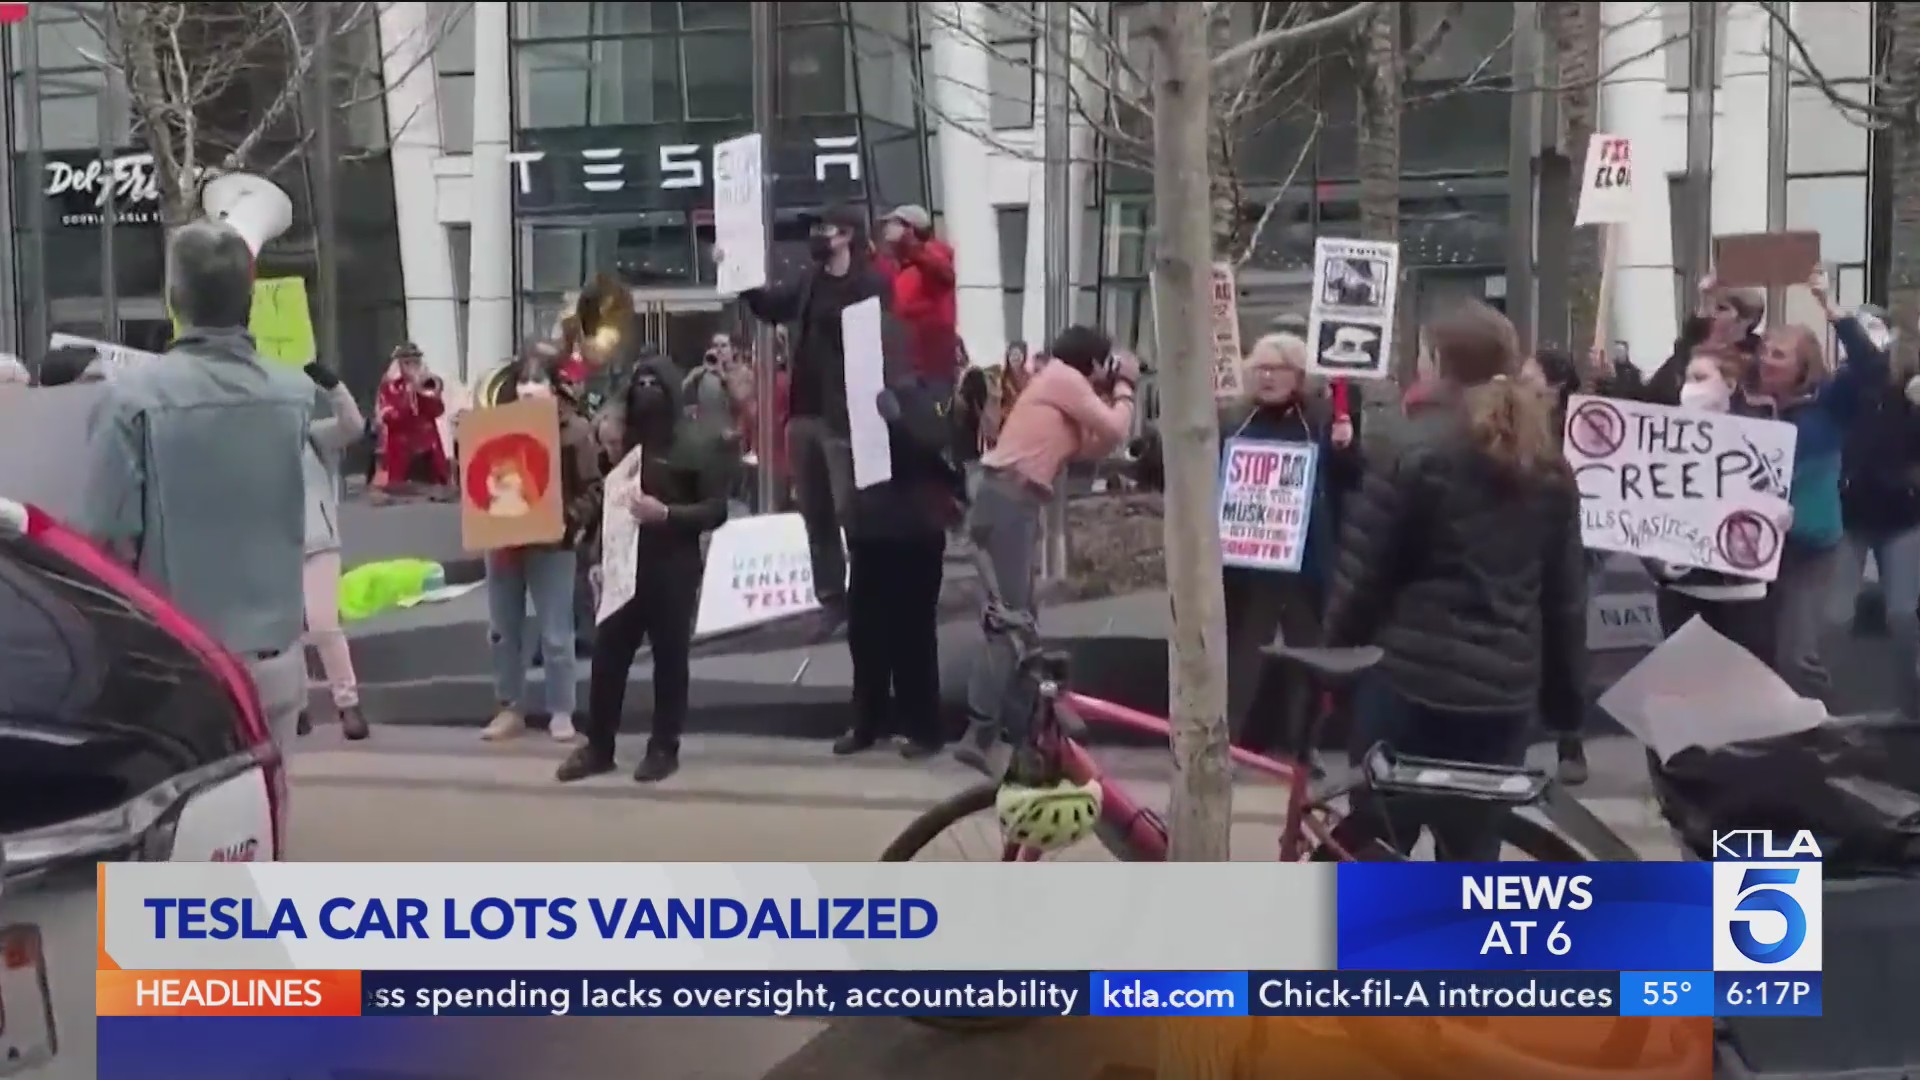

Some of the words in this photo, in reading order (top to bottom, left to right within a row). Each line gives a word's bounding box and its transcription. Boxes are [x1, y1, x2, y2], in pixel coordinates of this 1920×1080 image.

[506, 136, 860, 194] TESA
[1630, 411, 1714, 454] THIS
[1229, 450, 1280, 486] STOP
[1575, 449, 1751, 501] CREEP
